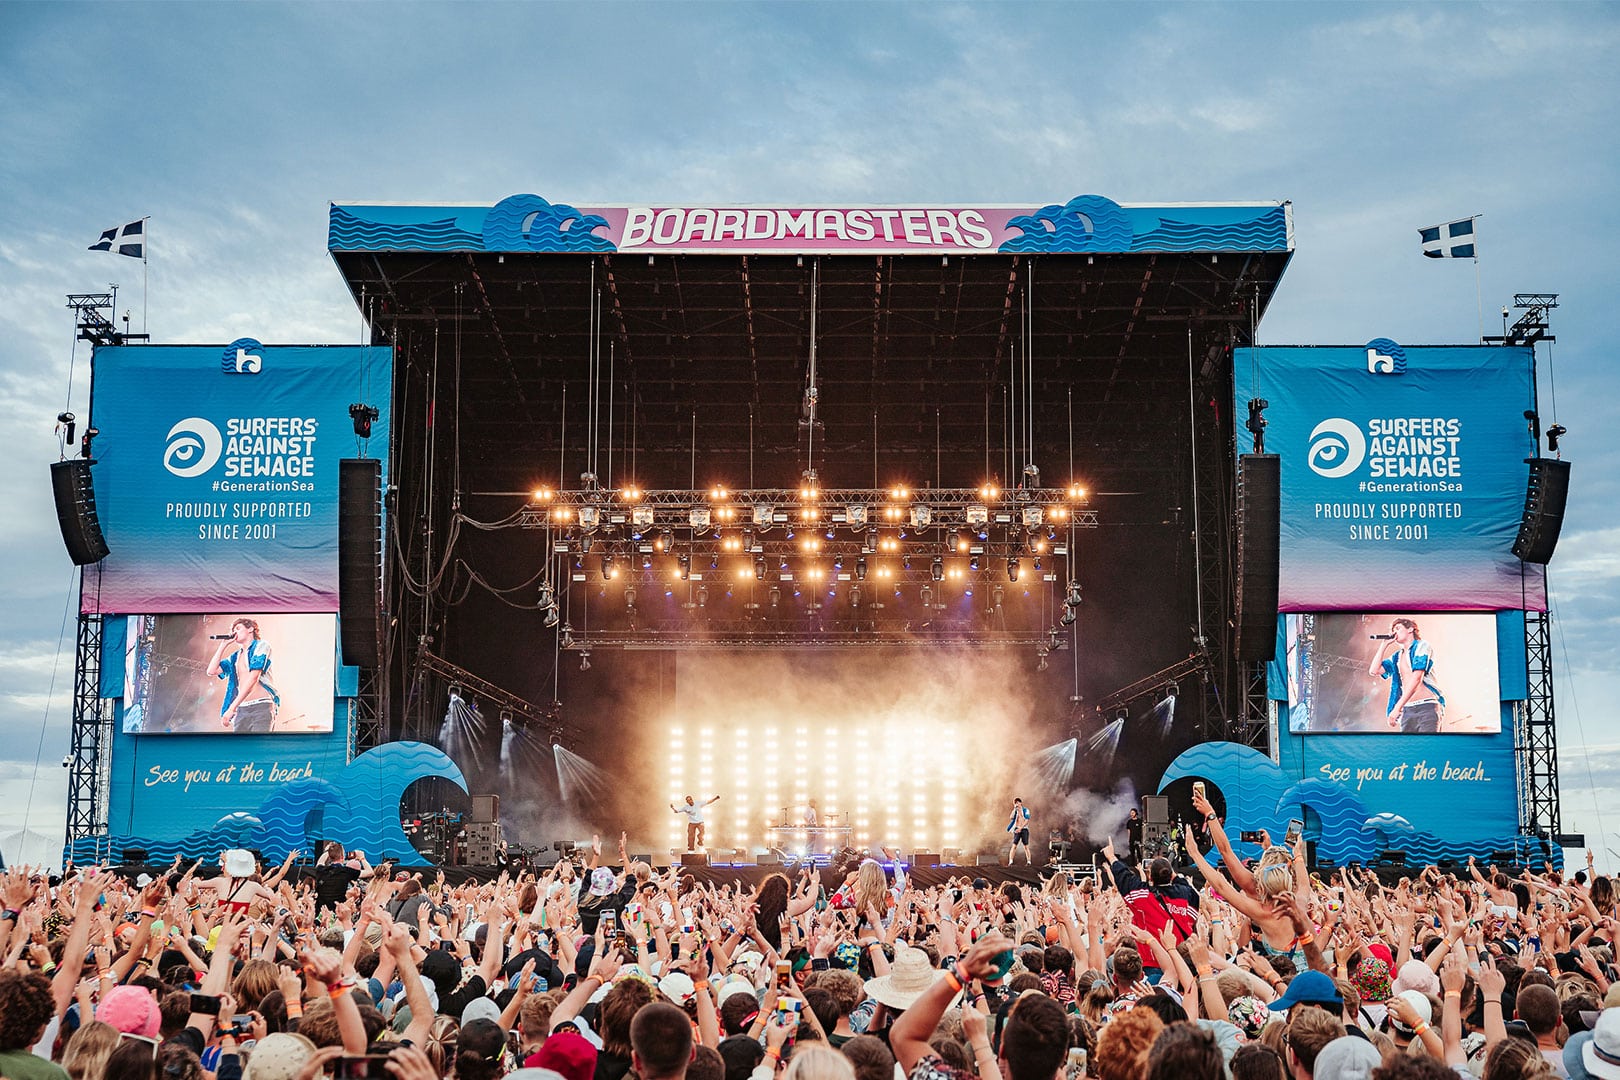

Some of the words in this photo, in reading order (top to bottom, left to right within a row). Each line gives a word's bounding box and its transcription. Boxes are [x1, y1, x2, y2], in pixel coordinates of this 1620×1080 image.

[618, 207, 994, 249] BOARDMASTERS
[225, 436, 317, 456] AGAINST
[1369, 437, 1461, 457] AGAINST
[224, 456, 315, 477] SEWAGE
[1369, 457, 1462, 478] SEWAGE
[211, 480, 315, 492] #GenerationSea
[1359, 481, 1463, 492] #GenerationSea
[166, 503, 228, 518] PROUDLY
[232, 502, 312, 518] SUPPORTED
[1315, 503, 1376, 519] PROUDLY
[1381, 503, 1463, 519] SUPPORTED
[198, 524, 239, 540] SINCE
[244, 524, 277, 540] 2001
[1350, 524, 1390, 540] SINCE
[1395, 524, 1429, 540] 2001
[144, 765, 179, 787] See
[184, 769, 211, 793] you
[215, 764, 236, 783] at
[239, 762, 264, 783] the
[1319, 763, 1350, 782] See
[1356, 766, 1383, 791] you
[1388, 762, 1409, 781] at
[1412, 760, 1437, 781] the
